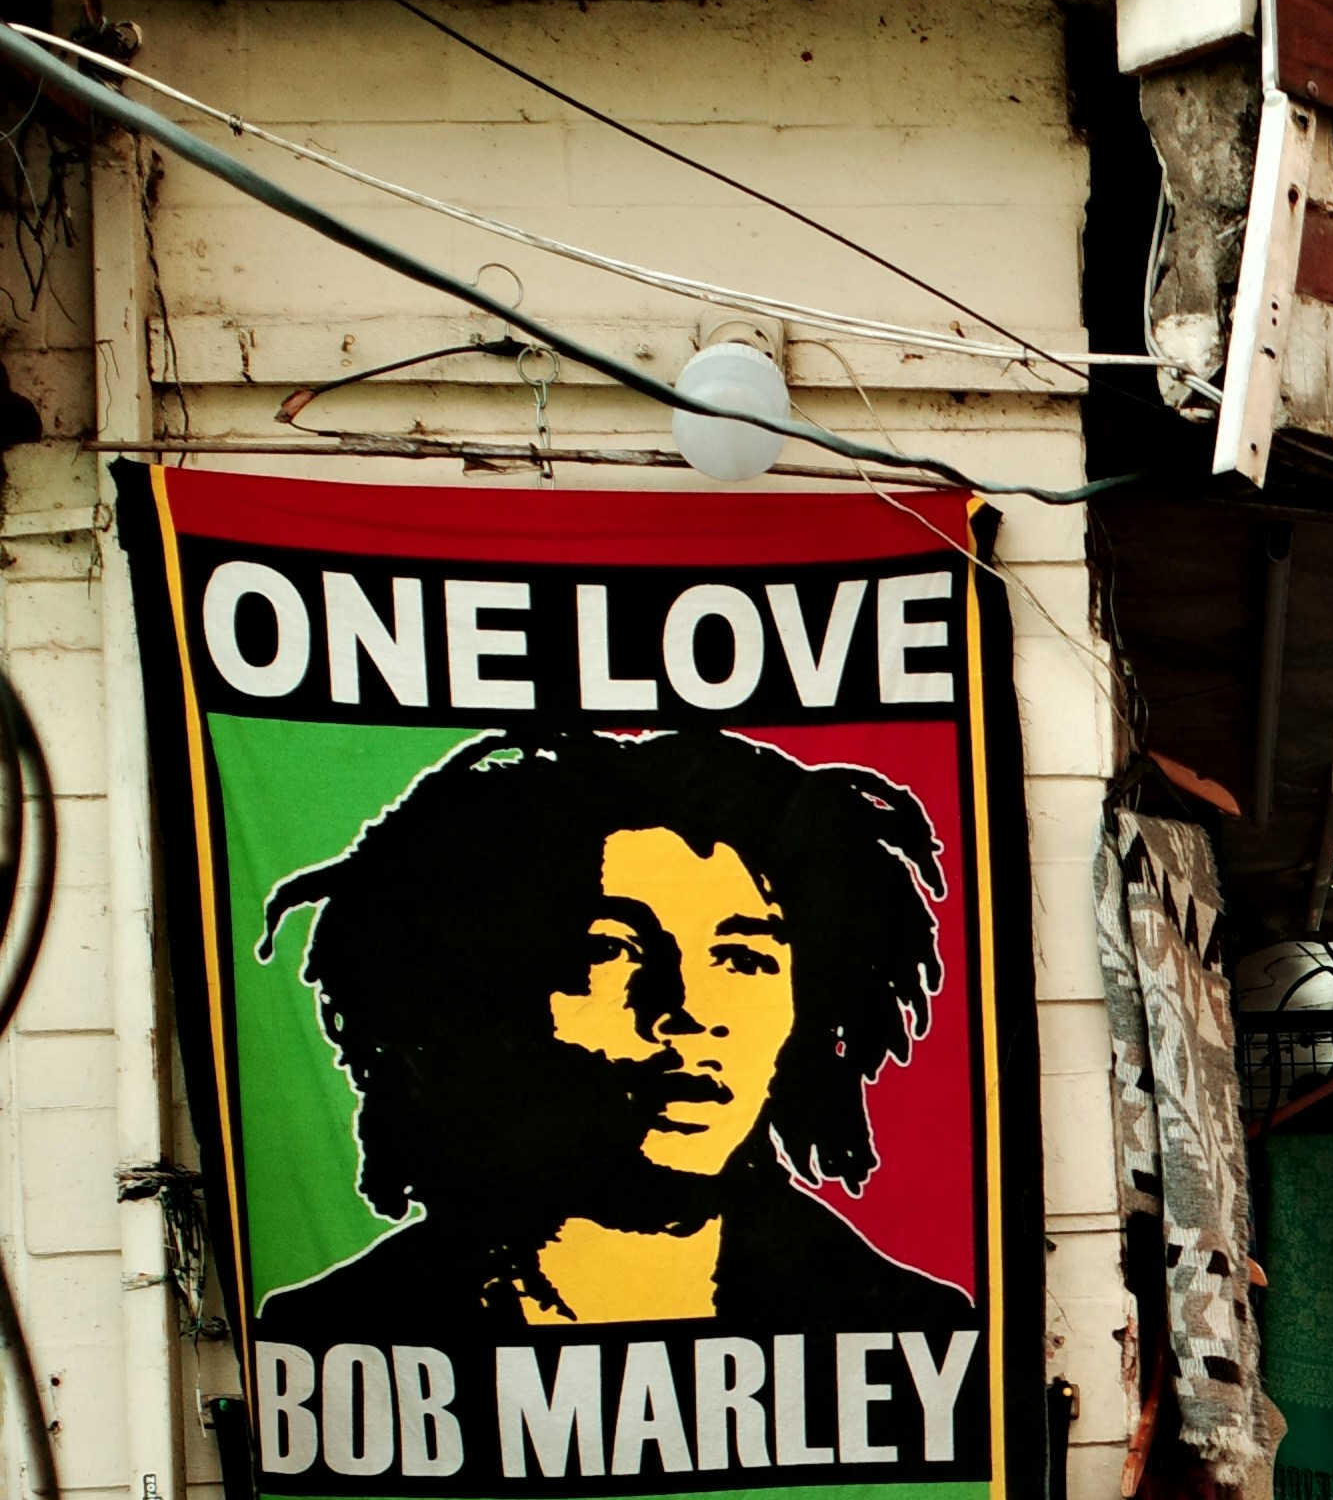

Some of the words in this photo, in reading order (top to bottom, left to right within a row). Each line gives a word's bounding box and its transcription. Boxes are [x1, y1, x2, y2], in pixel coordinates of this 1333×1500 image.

[203, 561, 536, 708] ONE
[576, 570, 955, 710] LOVE
[255, 1340, 464, 1476] BOB
[495, 1329, 978, 1477] MARLEY
